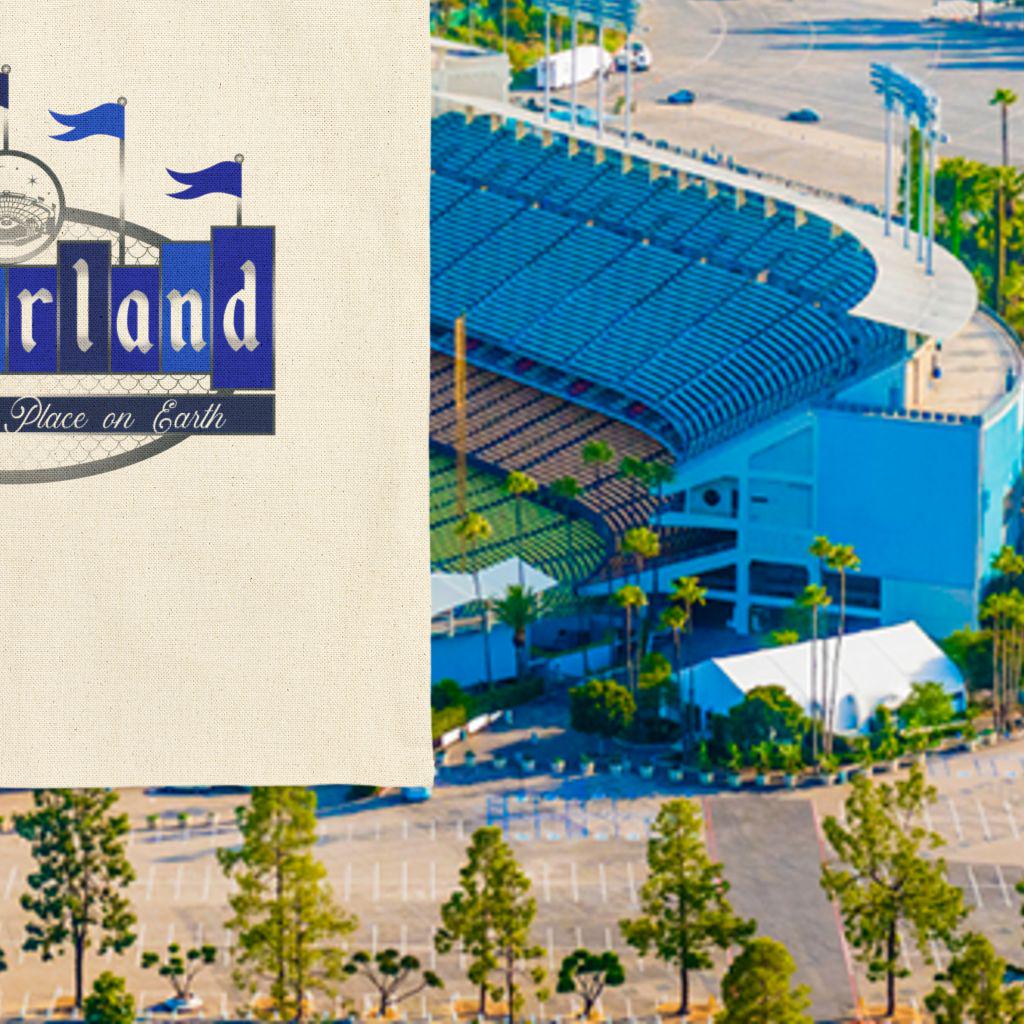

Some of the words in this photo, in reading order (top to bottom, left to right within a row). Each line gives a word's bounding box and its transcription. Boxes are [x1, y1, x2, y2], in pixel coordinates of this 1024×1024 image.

[3, 395, 89, 433] Place
[102, 411, 135, 429] on
[152, 398, 227, 434] Earth
